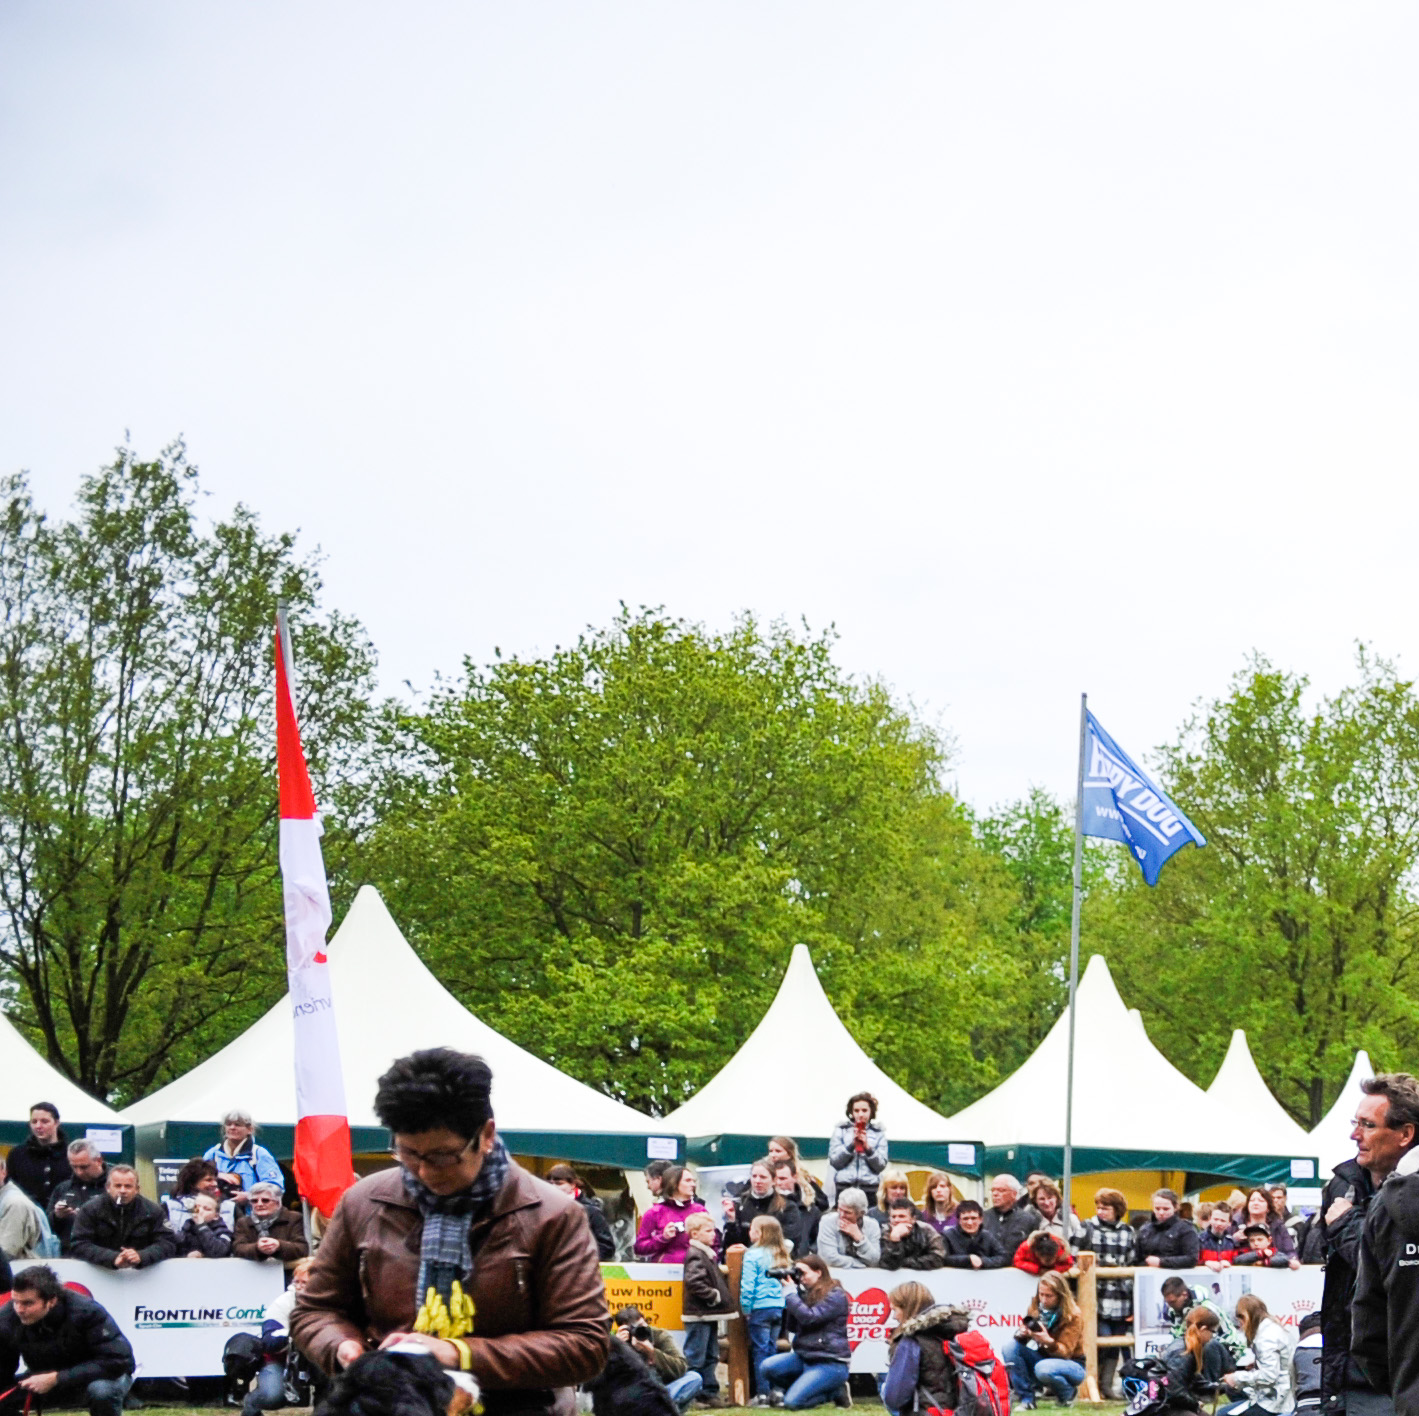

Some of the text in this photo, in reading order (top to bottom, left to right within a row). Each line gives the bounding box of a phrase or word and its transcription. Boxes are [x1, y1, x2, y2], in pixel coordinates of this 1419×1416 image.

[611, 1285, 673, 1297] uw hond
[134, 1305, 224, 1321] FRONTLINE
